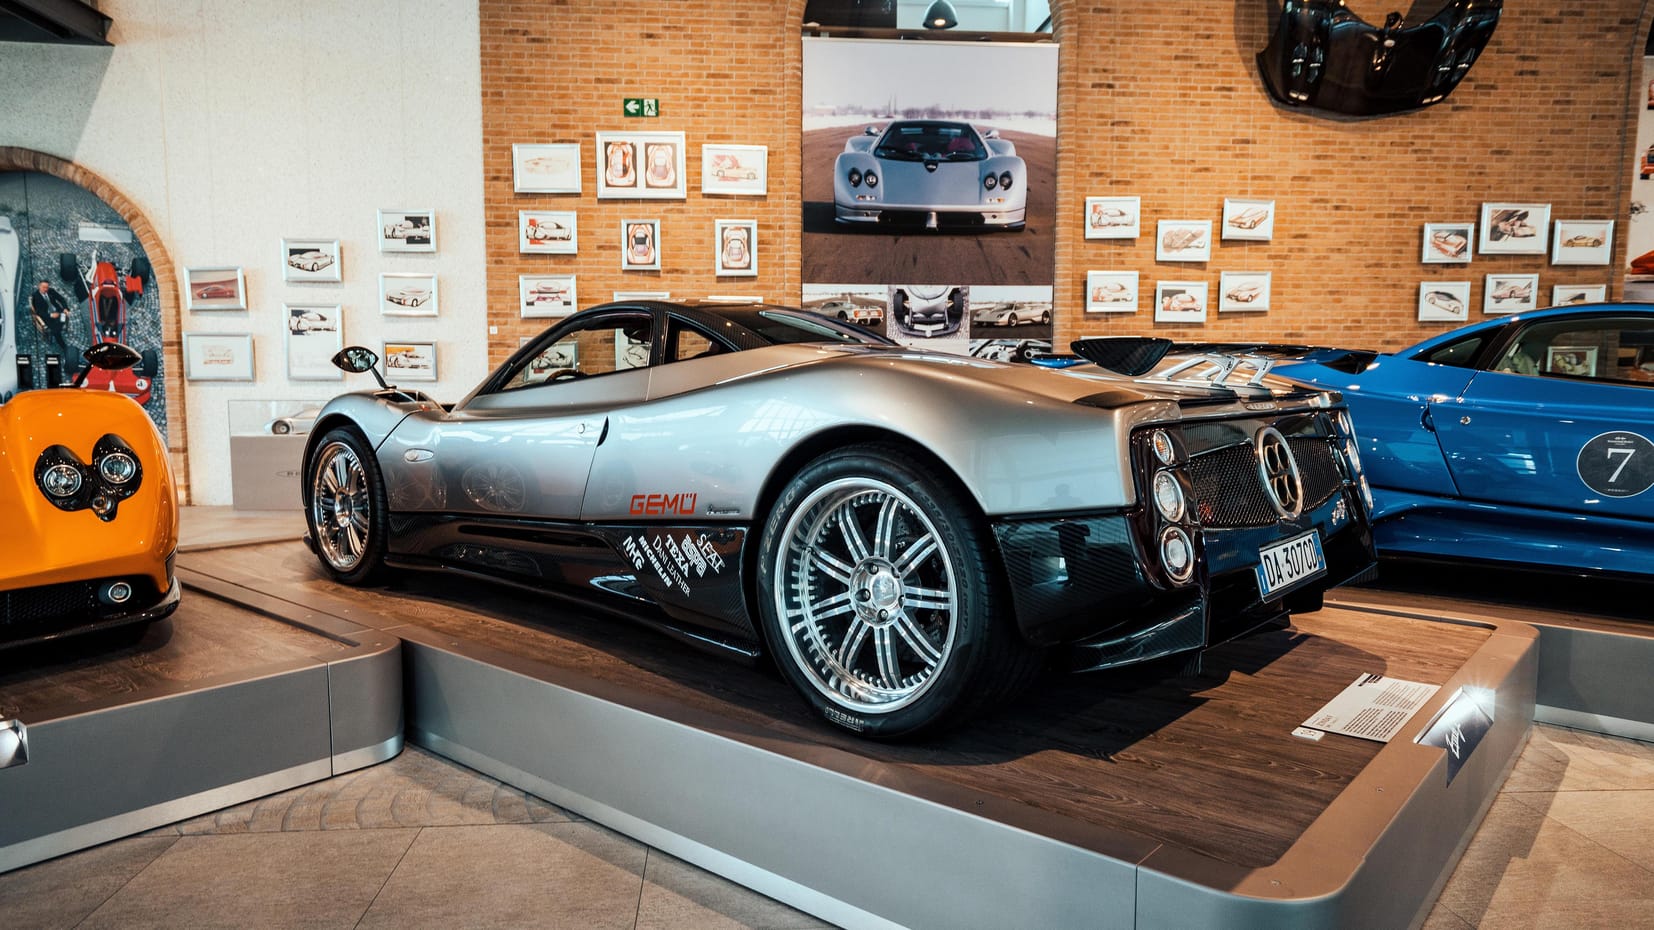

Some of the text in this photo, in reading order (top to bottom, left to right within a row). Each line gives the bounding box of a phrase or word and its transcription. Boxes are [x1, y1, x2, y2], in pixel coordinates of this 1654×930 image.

[1607, 448, 1636, 482] 7
[629, 492, 697, 515] GEMÜ
[764, 487, 795, 552] ZERO
[638, 535, 673, 588] MICHELIN
[665, 534, 690, 578] TEXA
[1263, 551, 1284, 587] DA
[1283, 538, 1318, 579] 307CD
[667, 561, 691, 598] LEATHER
